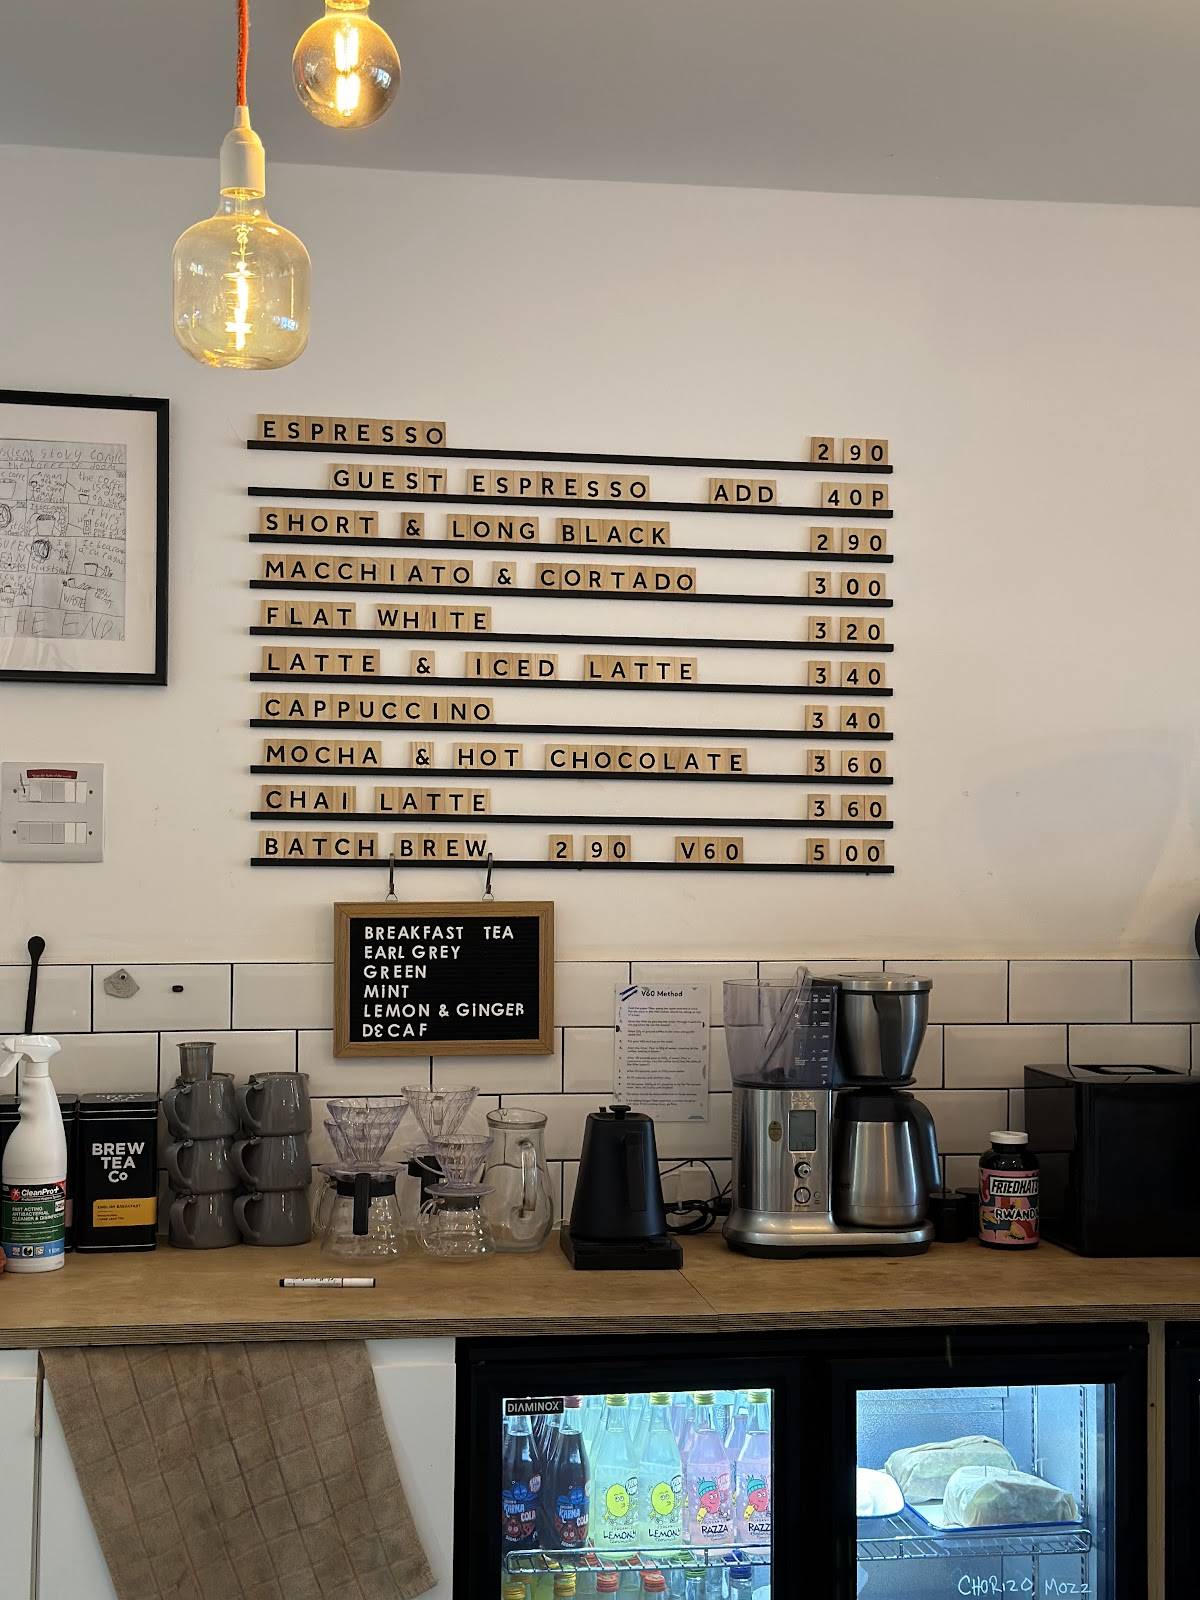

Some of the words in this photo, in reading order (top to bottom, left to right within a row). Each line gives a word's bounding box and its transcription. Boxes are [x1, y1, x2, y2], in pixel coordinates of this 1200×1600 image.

[263, 420, 444, 445] ESPRESSO
[333, 469, 443, 492] GUEST
[473, 474, 647, 499] ESPRESSO
[713, 484, 774, 503] ADD
[265, 513, 375, 535] SHORT
[405, 518, 421, 537] &
[452, 520, 535, 540] LONG
[562, 524, 666, 545] BLACK
[265, 560, 470, 584] MACCHIATO
[497, 567, 512, 585] &
[540, 569, 693, 591] CORTADO
[267, 606, 352, 626] FLAT
[377, 608, 487, 631] WHITE
[267, 652, 375, 673] LATTE
[416, 657, 431, 675] &
[476, 658, 555, 677] ICED
[589, 660, 692, 681] LATTE
[265, 698, 491, 721] CAPPUCCINO
[266, 745, 378, 765] MOCHA
[415, 748, 430, 766] &
[458, 748, 519, 767] HOT
[550, 749, 743, 772] CHOCOLATE
[265, 790, 347, 810] CHAI
[380, 792, 486, 812] LATTE
[265, 837, 375, 857] BATCH
[400, 839, 487, 857] BREW
[680, 842, 739, 861] V60
[364, 925, 464, 940] BREAKFAST
[483, 925, 514, 940] TEA
[364, 945, 405, 960] EARL
[411, 944, 461, 960] GREY
[363, 964, 427, 980] GREEN
[363, 1003, 430, 1018] LEMON
[438, 1003, 450, 1018] &
[92, 1142, 145, 1156] BREW
[101, 1156, 137, 1170] TEA
[108, 1170, 129, 1184] Co
[507, 1401, 560, 1413] DIAMINOX
[520, 1510, 536, 1522] COLA
[701, 1524, 729, 1534] RAZZA
